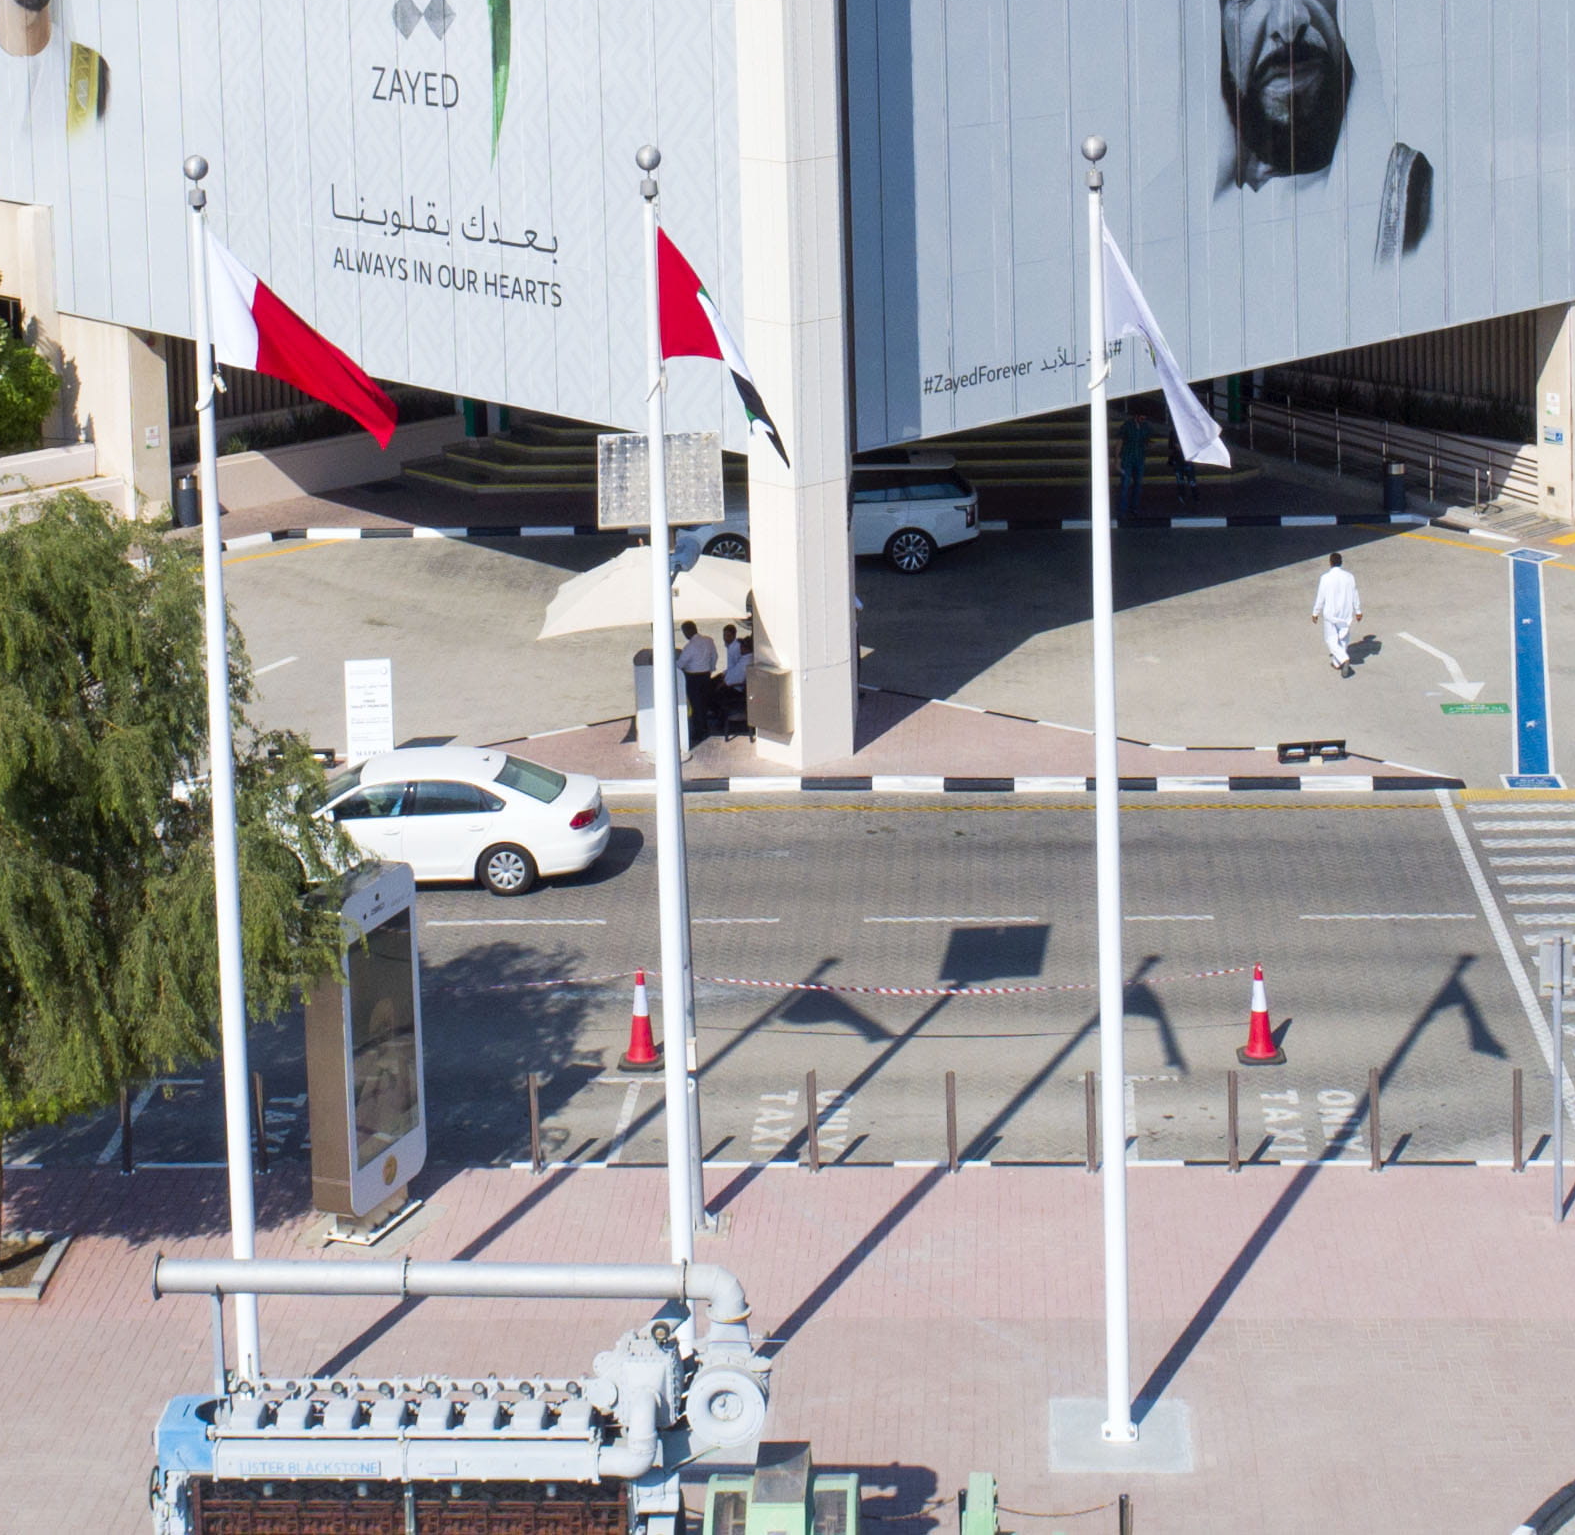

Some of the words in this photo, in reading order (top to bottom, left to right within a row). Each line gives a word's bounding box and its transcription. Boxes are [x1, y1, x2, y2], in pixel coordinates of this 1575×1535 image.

[372, 66, 460, 109] ZAYED
[331, 183, 450, 246] بقلوبنا
[462, 205, 558, 264] بعدك
[333, 246, 408, 281] ALWAYS
[413, 260, 432, 285] IN
[438, 264, 478, 294] OUR
[484, 271, 562, 308] HEARTS
[924, 359, 1033, 395] #ZayedForever
[750, 1089, 799, 1152] TAXI
[1260, 1088, 1307, 1153] TAXI
[1317, 1088, 1365, 1153] ONLY
[241, 1461, 283, 1474] LISTER
[287, 1460, 379, 1474] BLACKSTONE
